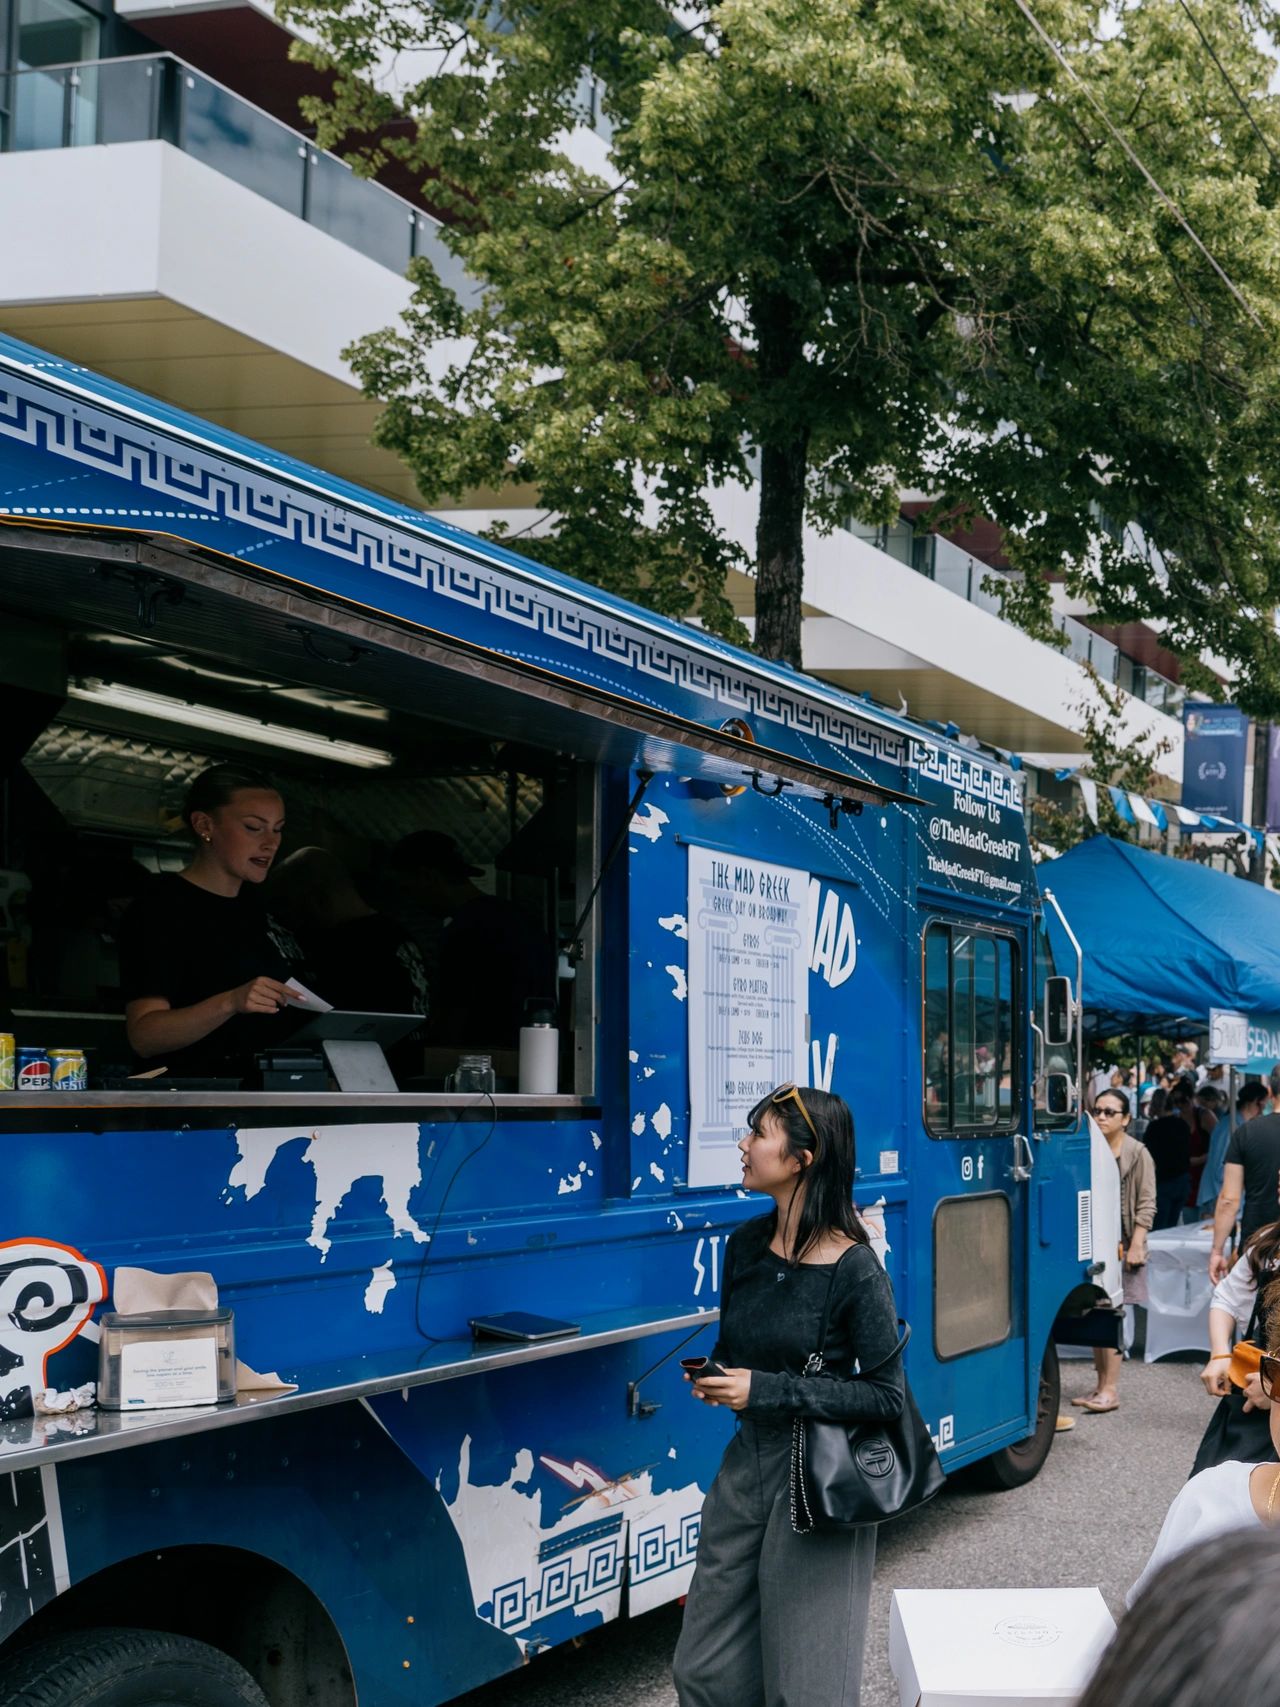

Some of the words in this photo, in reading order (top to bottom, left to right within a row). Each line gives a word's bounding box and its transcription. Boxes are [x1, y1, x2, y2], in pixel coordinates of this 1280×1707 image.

[953, 789, 986, 819] Follow
[988, 801, 1001, 824] Us
[929, 816, 1021, 862] @TheMadGreekFT
[711, 861, 730, 890] THE
[735, 866, 755, 895] MAD
[759, 872, 790, 903] GREEK
[927, 855, 1022, 894] TheMadGreekFT@gmail.com
[713, 895, 733, 914] GREEK
[735, 900, 746, 917] DAY
[748, 902, 756, 918] ON
[758, 904, 788, 923] BROADWAY
[743, 933, 760, 950] GYROS
[733, 977, 748, 992] GYRO
[749, 979, 769, 995] PLATTER
[752, 1031, 763, 1045] DOG
[725, 1081, 736, 1096] MAD
[737, 1081, 754, 1097] GREEK
[756, 1082, 776, 1097] POUTIN
